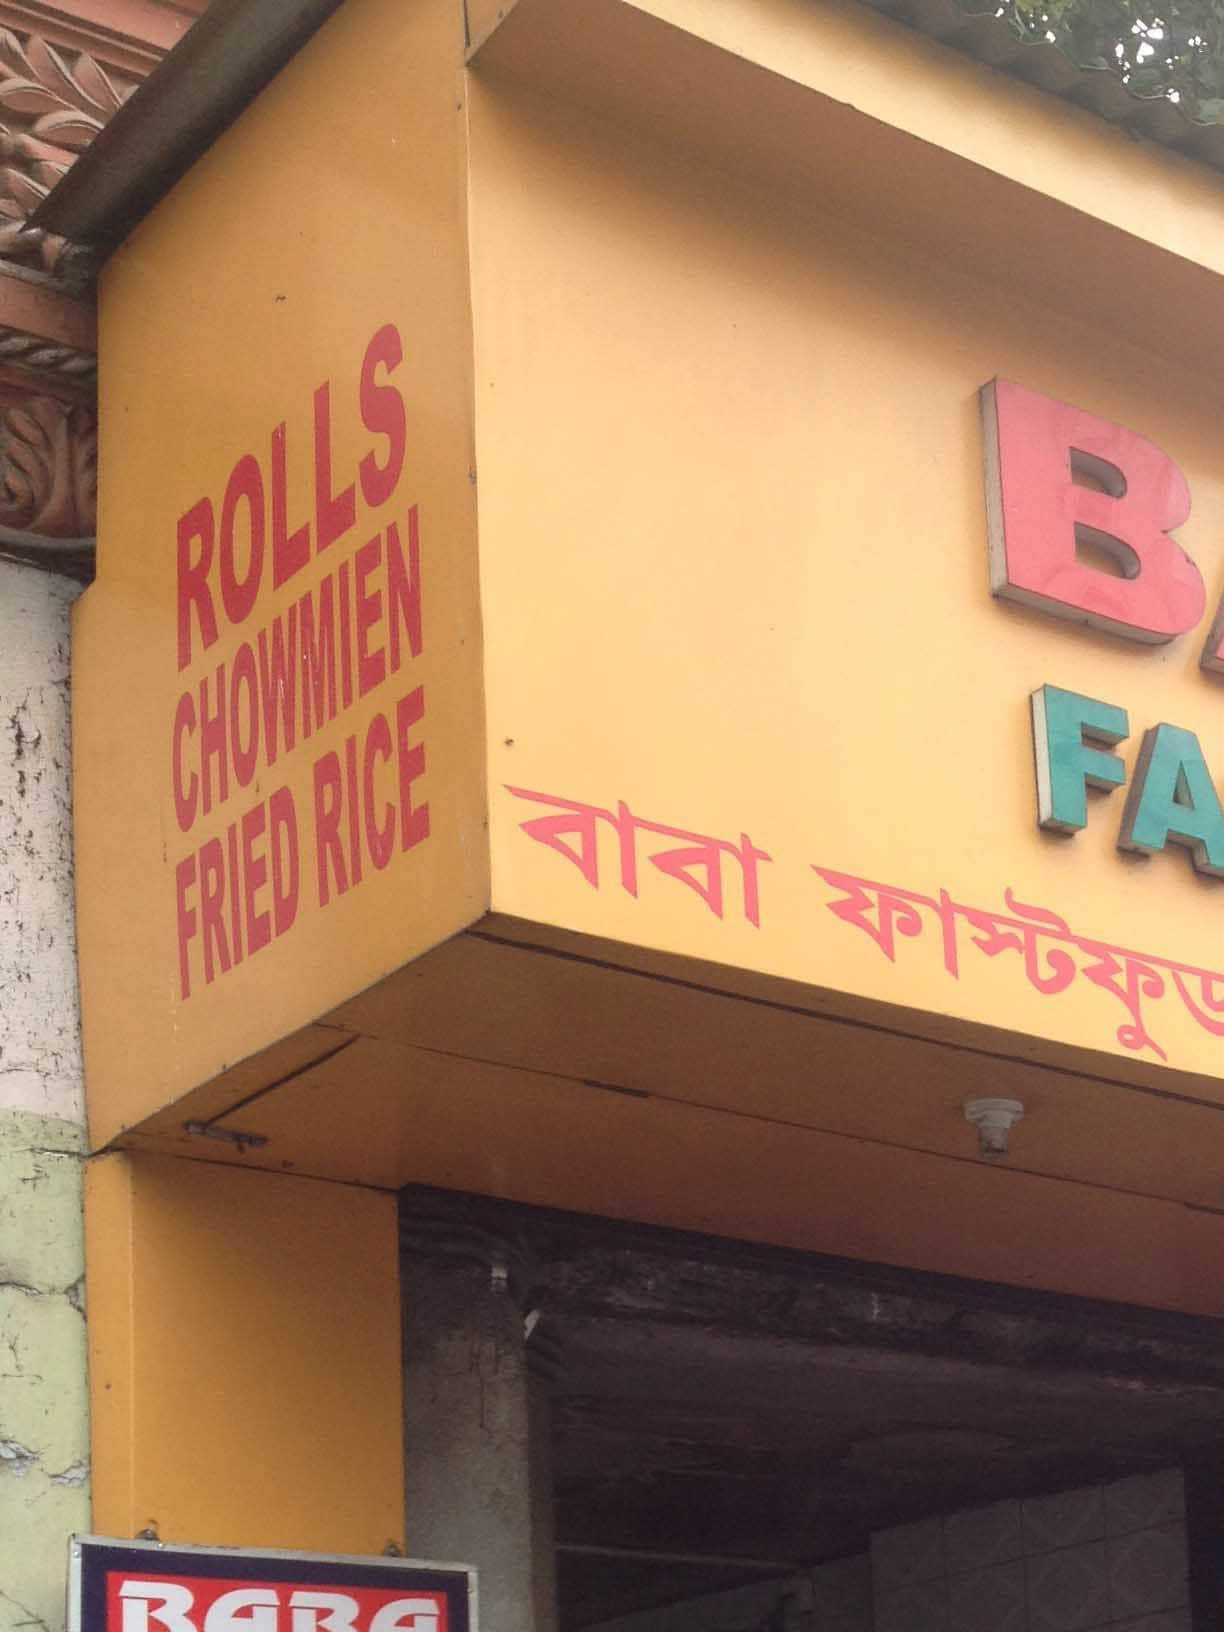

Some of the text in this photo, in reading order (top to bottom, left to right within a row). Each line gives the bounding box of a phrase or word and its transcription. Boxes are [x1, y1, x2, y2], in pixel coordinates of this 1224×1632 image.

[177, 322, 407, 672] ROLLS
[172, 504, 424, 833] CHOWMIEN
[175, 684, 431, 1001] FRIED RICE
[503, 784, 773, 930] বাবা
